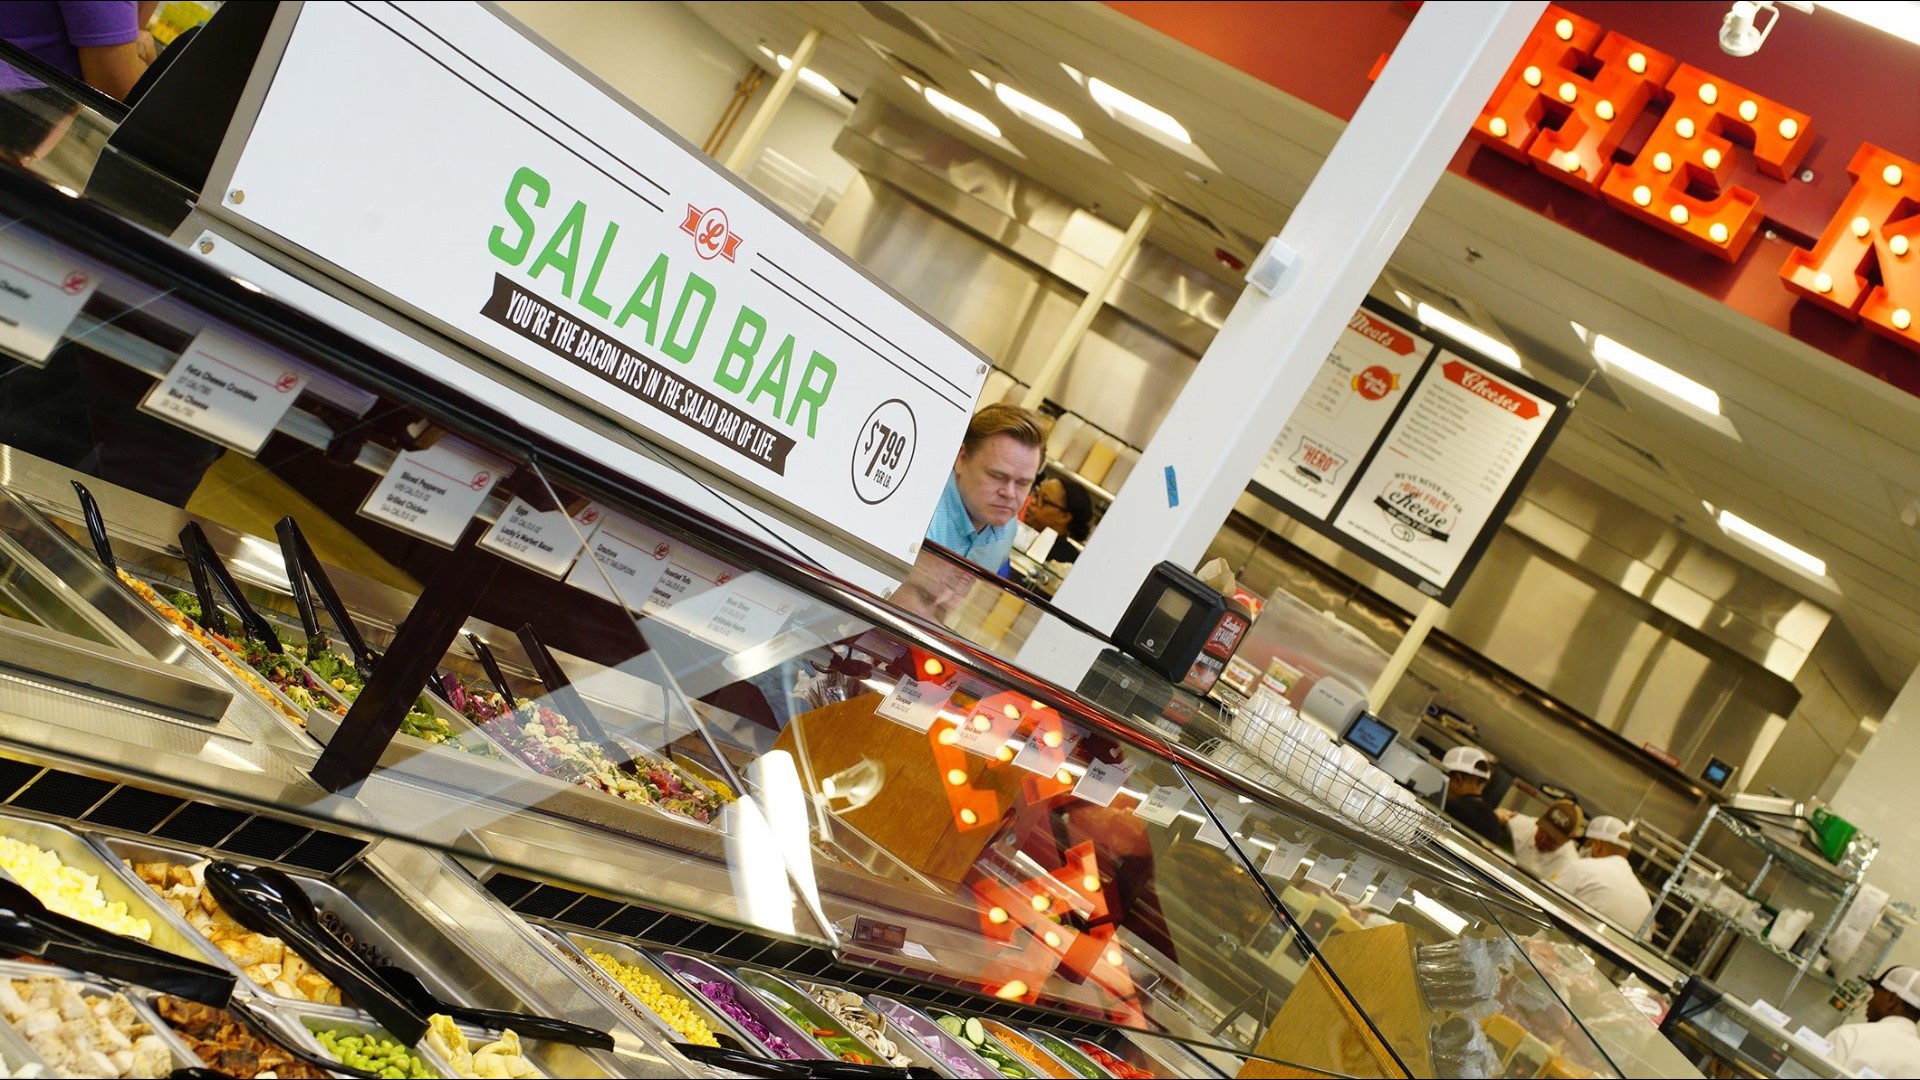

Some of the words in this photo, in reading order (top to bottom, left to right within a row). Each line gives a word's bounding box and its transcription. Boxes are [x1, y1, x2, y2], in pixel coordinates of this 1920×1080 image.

[488, 166, 717, 365] SALAD
[713, 304, 837, 439] BAR
[1351, 313, 1395, 347] Meats
[201, 372, 227, 388] Cheese
[505, 290, 556, 340] YOU'RE
[550, 315, 581, 353] THE
[574, 329, 621, 375] BACON
[616, 353, 648, 389] BITS
[643, 368, 662, 398] IN
[658, 375, 685, 410] THE
[679, 388, 719, 428] SALAD
[714, 408, 740, 441] BAR
[736, 421, 756, 448] OF
[750, 428, 777, 462] LIFE.
[1462, 370, 1521, 412] Cheeses
[418, 477, 447, 495] Pepperoni
[873, 469, 886, 485] PER
[1419, 477, 1442, 492] NEVER
[405, 499, 428, 515] Chicken
[515, 505, 529, 517] Eggs
[1389, 491, 1448, 528] cheese
[1423, 494, 1448, 513] FREE
[501, 525, 521, 540] Lucky's
[521, 534, 539, 547] Market
[538, 541, 554, 553] Bacon
[597, 544, 618, 558] Croutons
